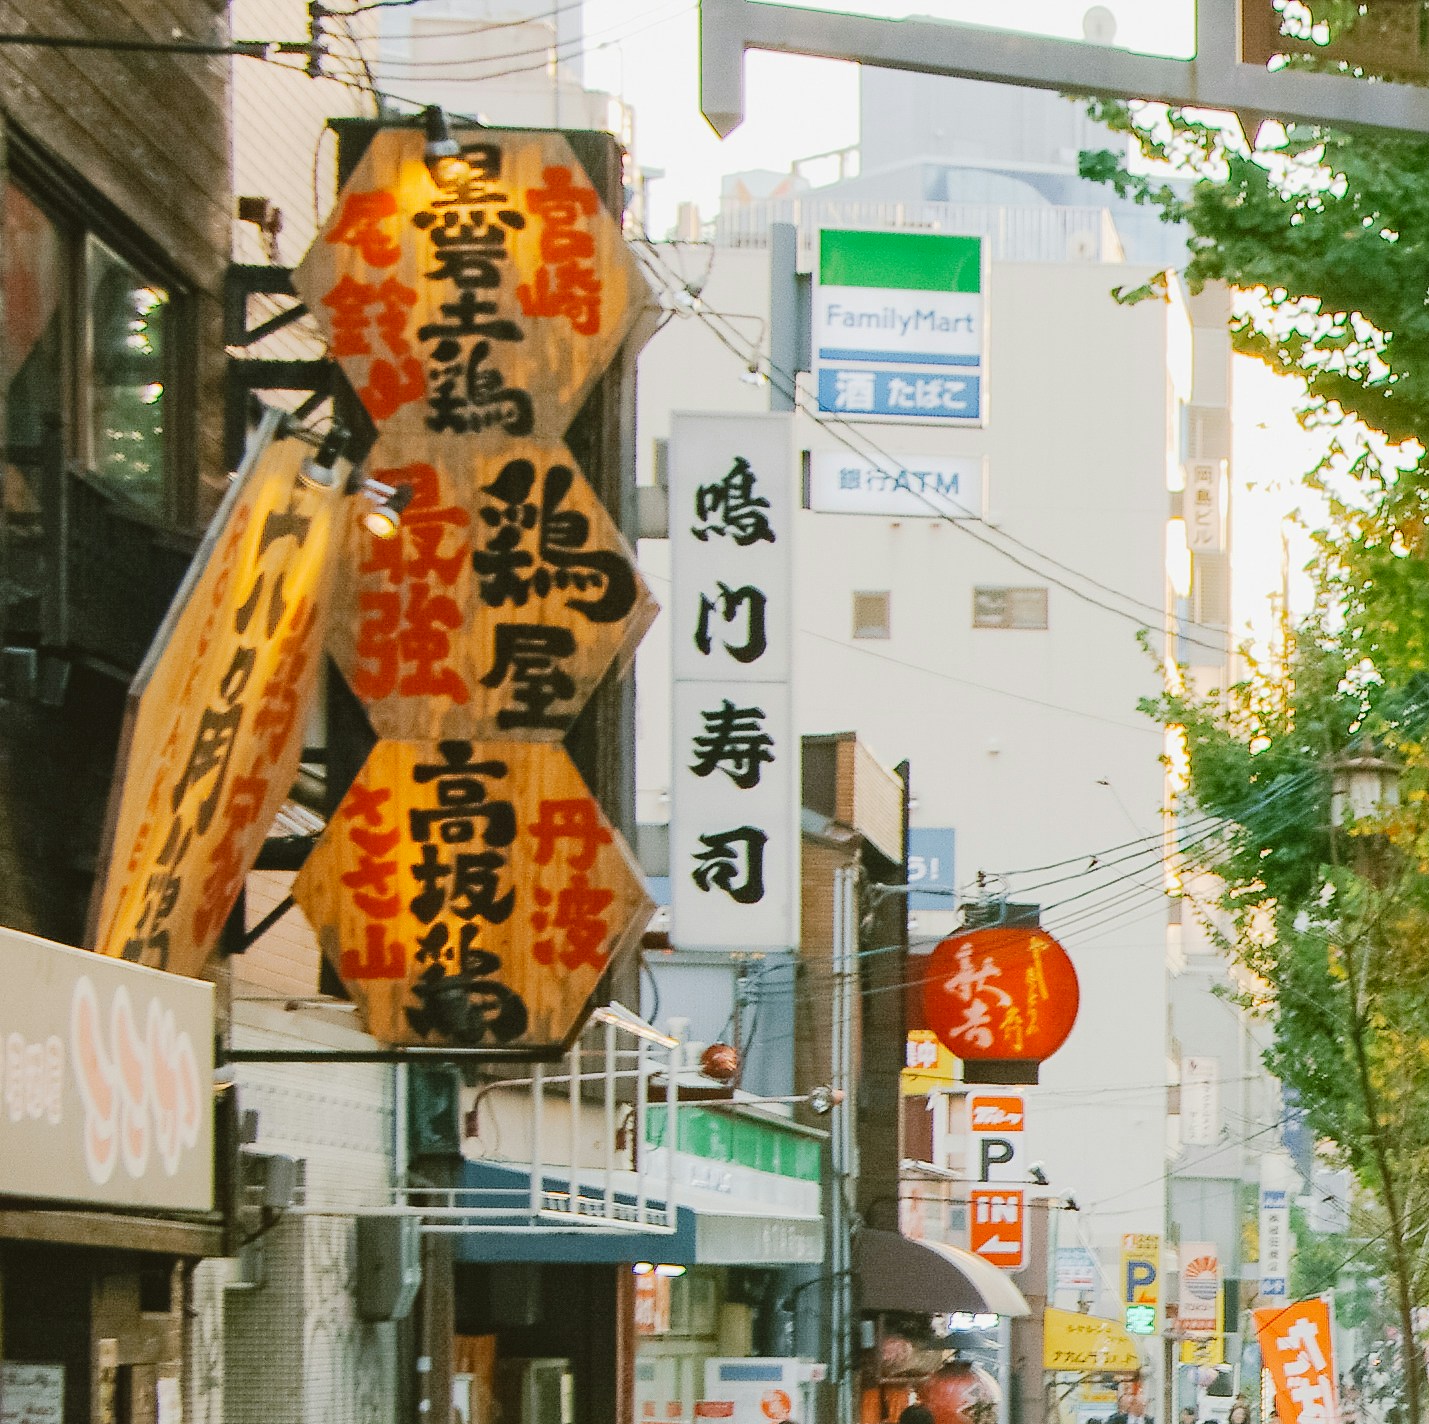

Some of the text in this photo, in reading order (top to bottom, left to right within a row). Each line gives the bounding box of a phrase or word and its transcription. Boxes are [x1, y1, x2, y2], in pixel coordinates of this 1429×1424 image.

[516, 165, 602, 336] 宮崎
[826, 303, 975, 337] FamilyMart
[836, 371, 968, 412] 酒 たばこ
[473, 458, 638, 730] 鶏屋
[688, 455, 777, 905] 鳴門寿司
[981, 1138, 1015, 1183] P
[976, 1196, 1019, 1224] IN
[1127, 1260, 1157, 1303] P
